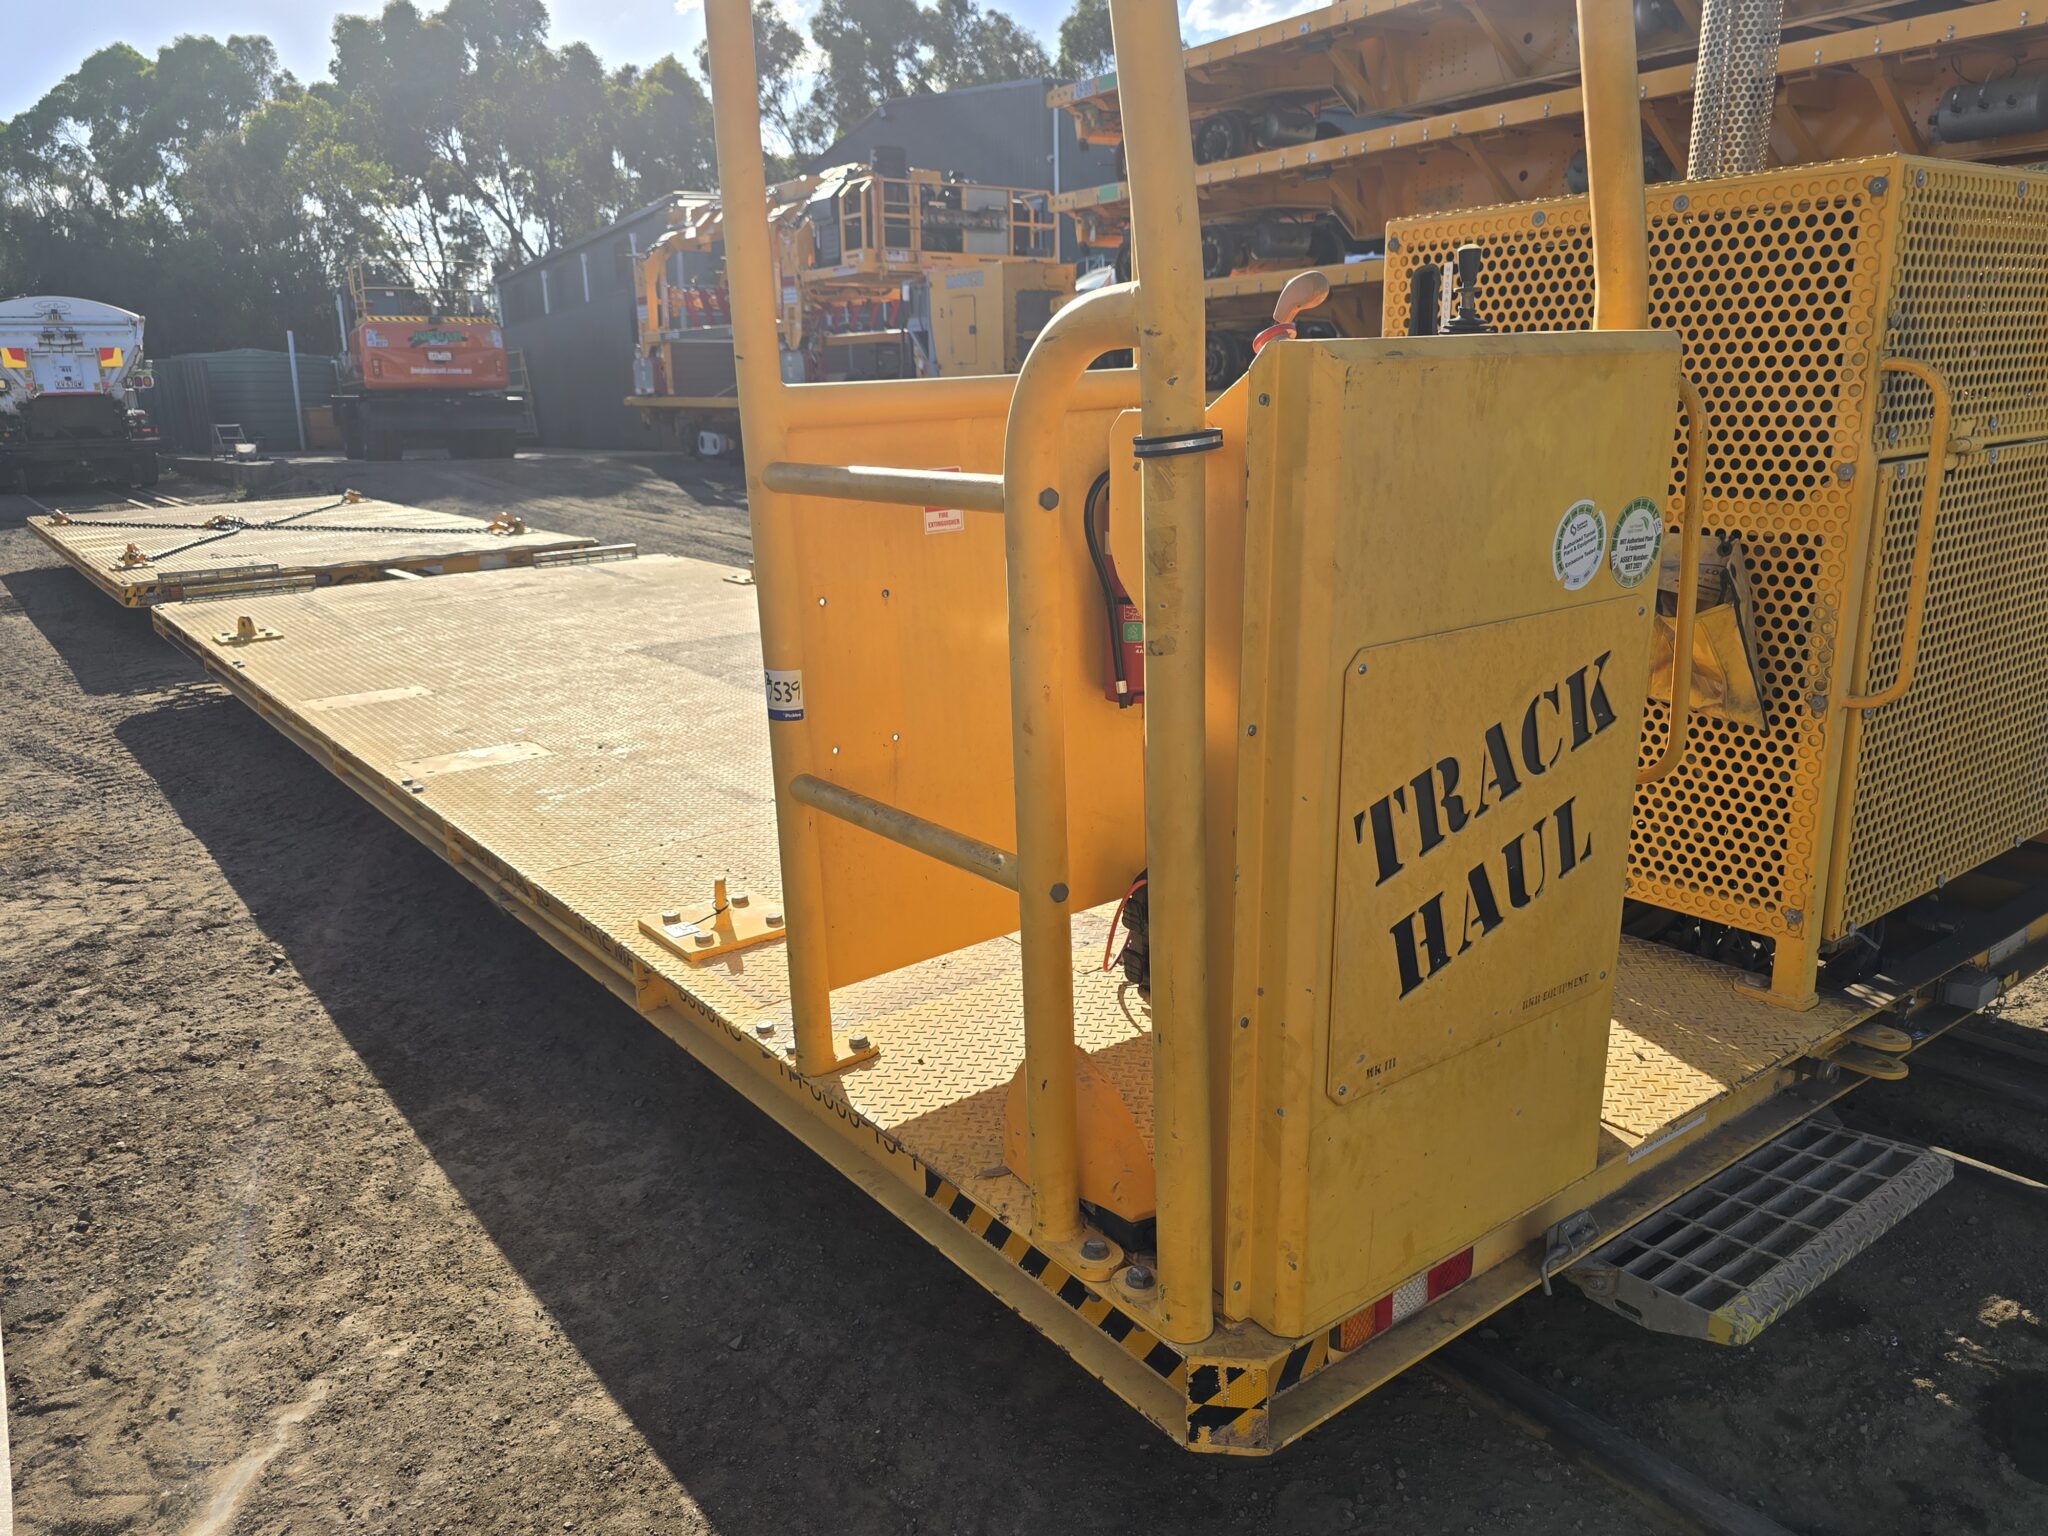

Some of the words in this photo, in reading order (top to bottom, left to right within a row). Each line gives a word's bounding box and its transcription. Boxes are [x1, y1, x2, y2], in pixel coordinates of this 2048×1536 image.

[928, 519, 960, 528] EXTINGUISHER
[1620, 555, 1633, 564] ASSET
[1353, 649, 1617, 887] TRACK
[1389, 795, 1593, 1000] HAUL
[1542, 972, 1590, 1002] EQUIPMENT
[1366, 1063, 1382, 1080] MK
